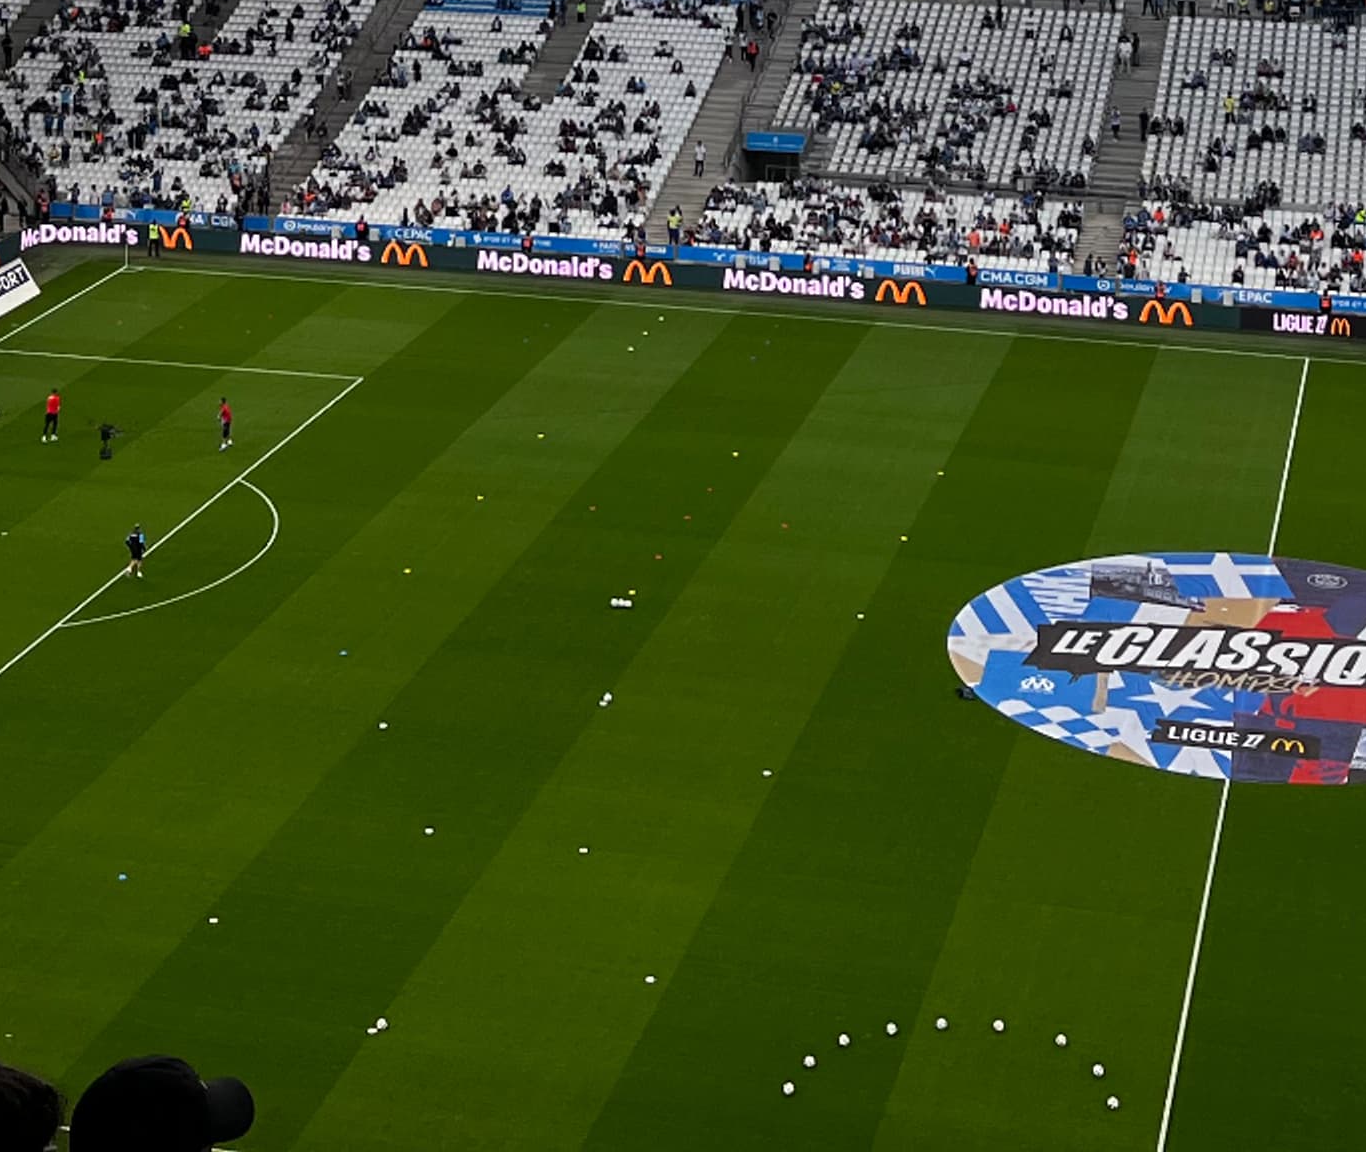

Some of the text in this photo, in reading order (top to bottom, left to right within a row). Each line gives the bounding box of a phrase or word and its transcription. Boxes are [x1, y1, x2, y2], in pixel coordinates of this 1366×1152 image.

[21, 222, 138, 251] McDonald's
[240, 233, 371, 261] McDonald's
[395, 228, 433, 241] CEPAC
[477, 250, 613, 280] McDonald's
[980, 270, 1012, 284] CMA
[723, 268, 865, 300] McDonald's
[980, 288, 1128, 320] McDonald's
[1272, 313, 1315, 334] LIGUE
[1051, 629, 1103, 655] LE
[1167, 726, 1242, 746] LIGUE
